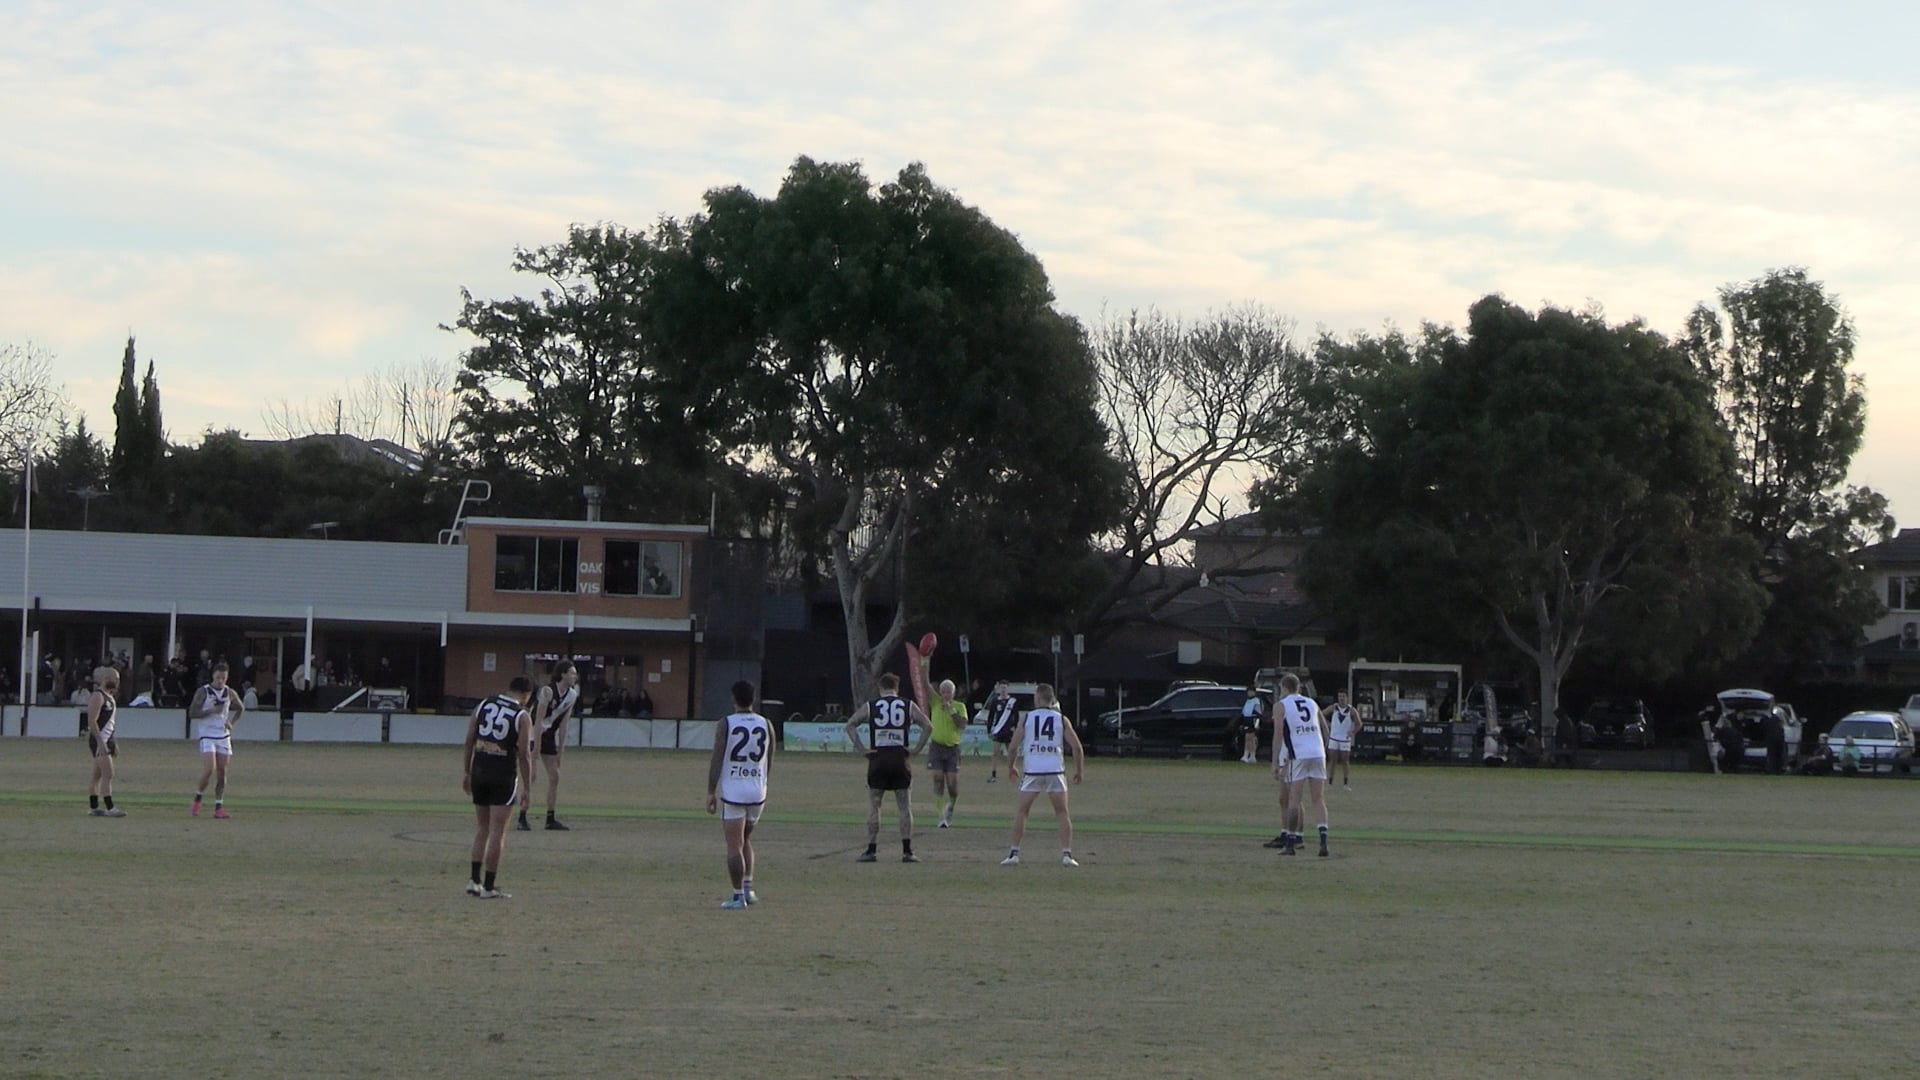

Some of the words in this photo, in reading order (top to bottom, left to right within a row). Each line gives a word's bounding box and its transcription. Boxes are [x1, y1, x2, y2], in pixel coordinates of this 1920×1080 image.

[580, 562, 603, 574] OAK
[580, 582, 601, 594] VIS
[478, 702, 517, 741] 35
[874, 699, 906, 728] 36
[1294, 699, 1311, 722] 5
[1034, 715, 1056, 742] 14
[730, 726, 767, 762] 23
